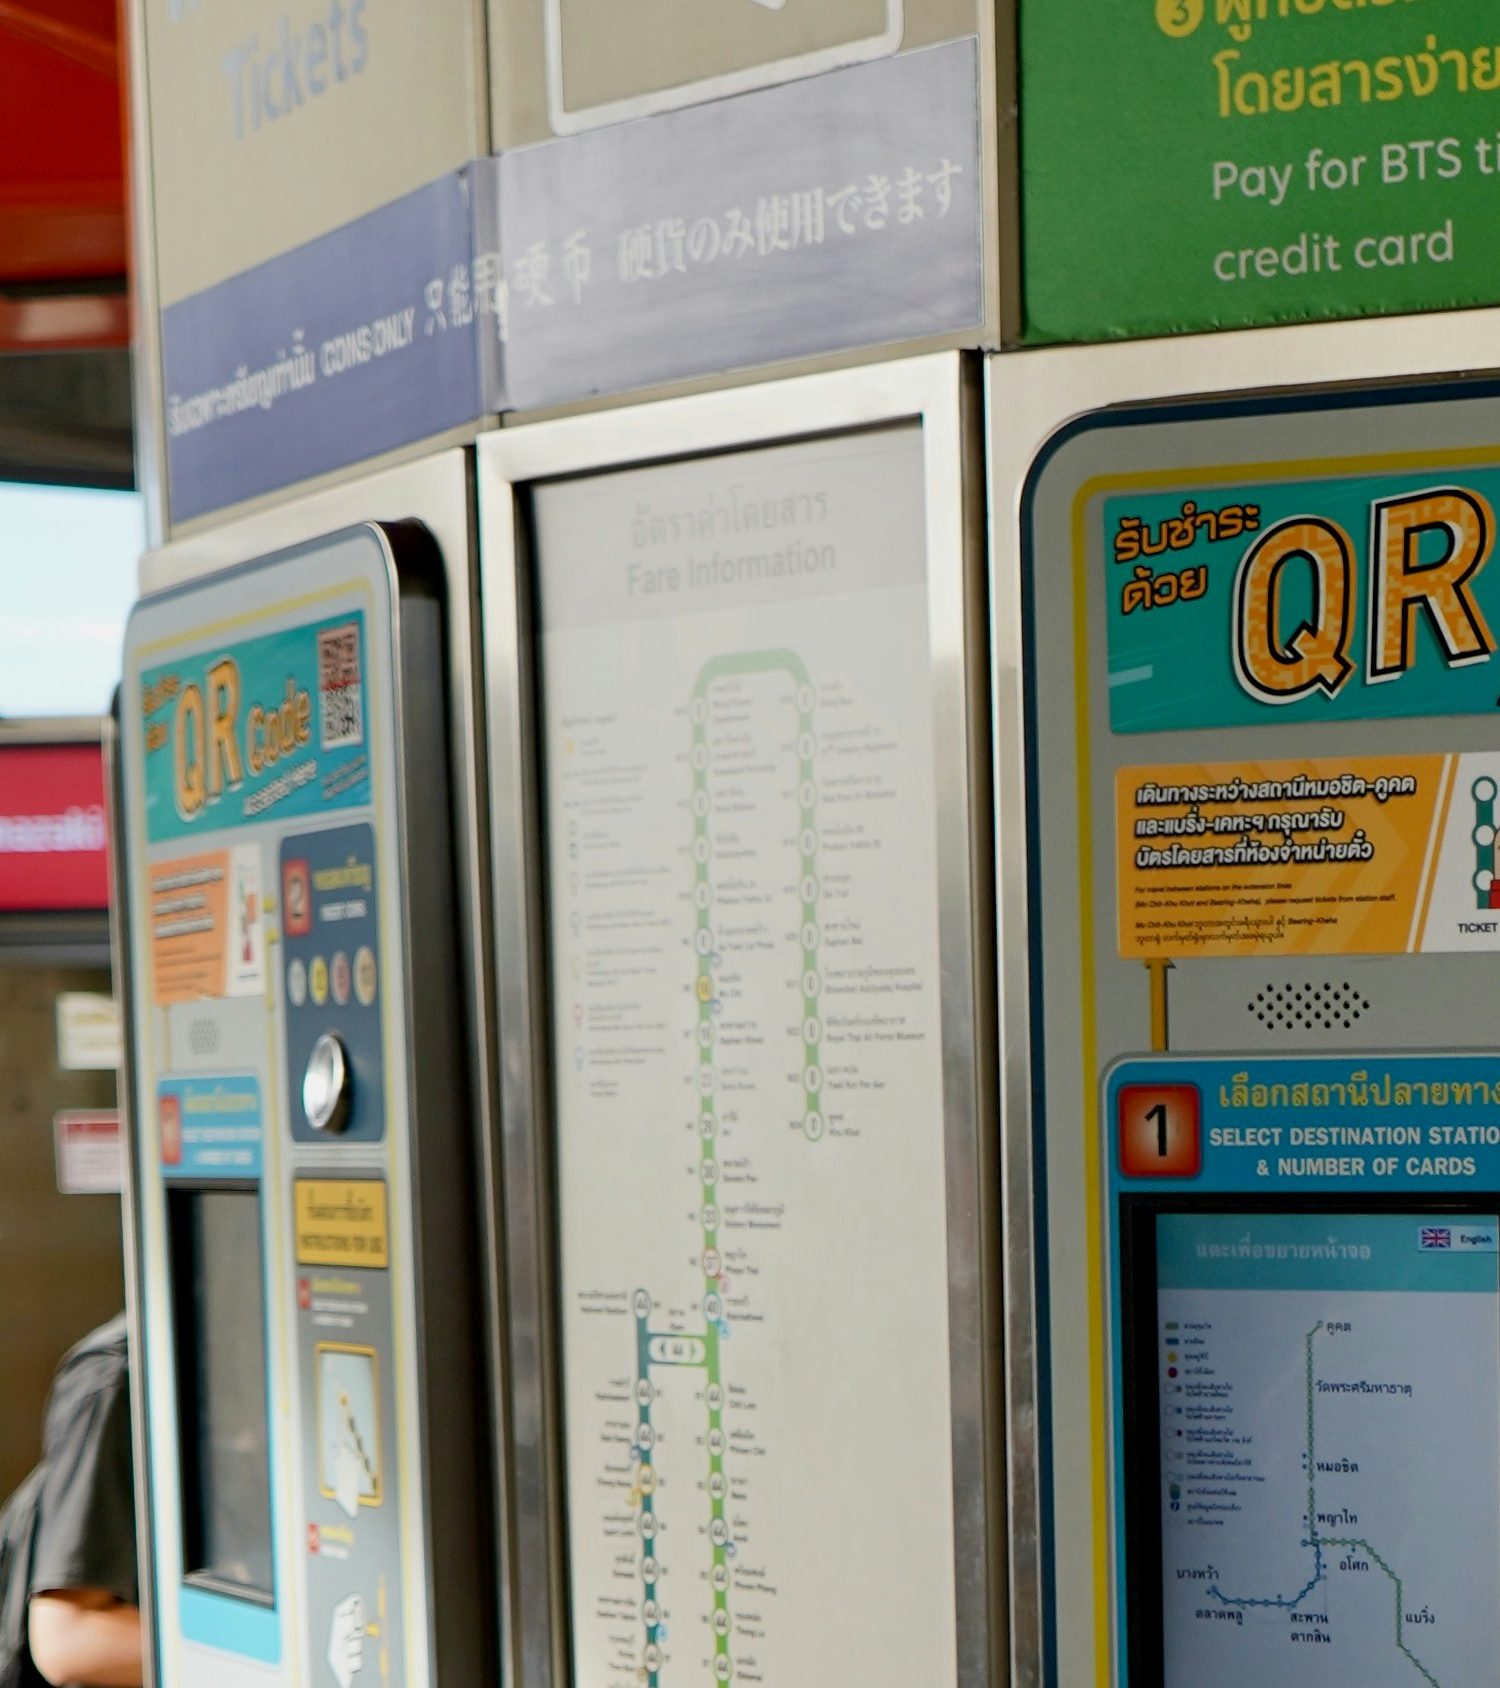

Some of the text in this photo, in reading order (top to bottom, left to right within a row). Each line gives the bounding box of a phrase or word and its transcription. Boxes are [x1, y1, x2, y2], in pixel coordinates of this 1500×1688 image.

[229, 0, 371, 139] Tickets
[1213, 160, 1292, 204] Pay
[1305, 149, 1367, 190] for
[1381, 139, 1461, 181] BTS
[617, 158, 965, 287] 硬貨のみ使用できます
[1213, 221, 1454, 281] credit card
[320, 309, 415, 378] COINS ONLY
[630, 485, 828, 548] อัตราค่าโดยสาร
[1113, 500, 1262, 565] รับชำระ
[627, 541, 837, 598] Fare Information
[1121, 565, 1208, 615] ด้วย
[1233, 486, 1495, 703] QR
[1135, 774, 1417, 806] เดินทางระหว่างสถานีหมอชิต-คูคต
[1267, 808, 1344, 834] กรุณารับ
[1135, 831, 1374, 869] บัตรโดยสารที่ห้องจำหน่ายตั๋ว
[1457, 922, 1497, 934] TICKET
[1144, 1104, 1168, 1157] 1
[1210, 1127, 1280, 1147] SELECT
[1289, 1126, 1422, 1146] DESTINATION
[1256, 1157, 1476, 1176] & NUMBER OF CARDS
[1459, 1234, 1492, 1246] English
[1176, 1564, 1219, 1582] บางหว้า
[1339, 1557, 1369, 1572] อโศก
[1290, 1610, 1328, 1626] สะพาน
[1405, 1605, 1435, 1626] แบริ่ง
